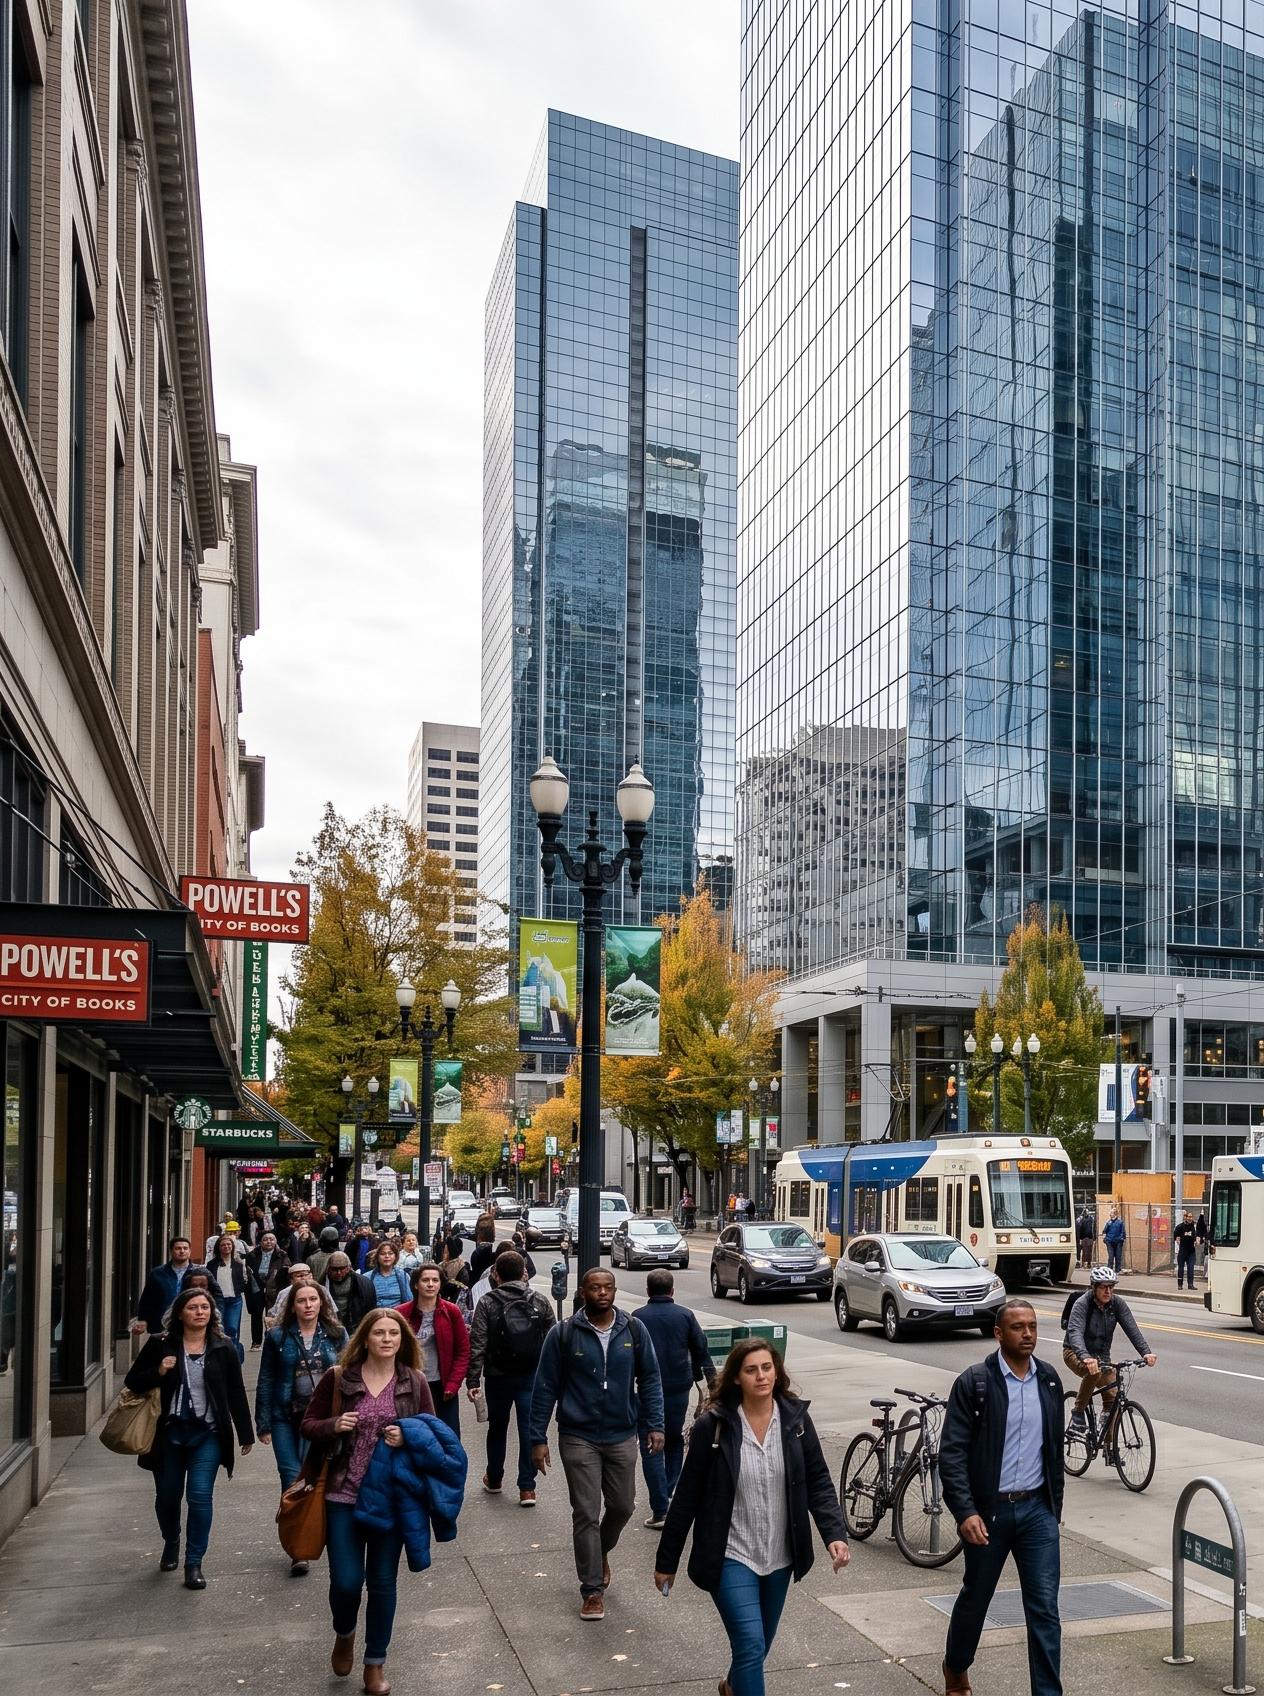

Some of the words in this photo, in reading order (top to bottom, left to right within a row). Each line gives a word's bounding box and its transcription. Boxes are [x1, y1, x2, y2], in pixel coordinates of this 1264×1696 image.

[188, 882, 301, 918] POWELL'S
[200, 919, 223, 930] ITY
[226, 920, 247, 931] OF
[250, 922, 300, 934] BOOKS
[1, 943, 139, 983] POWELL'S
[2, 994, 41, 1007] CITY
[47, 996, 70, 1008] OF
[76, 998, 136, 1011] BOOKS
[202, 1128, 273, 1138] STARBUCKS
